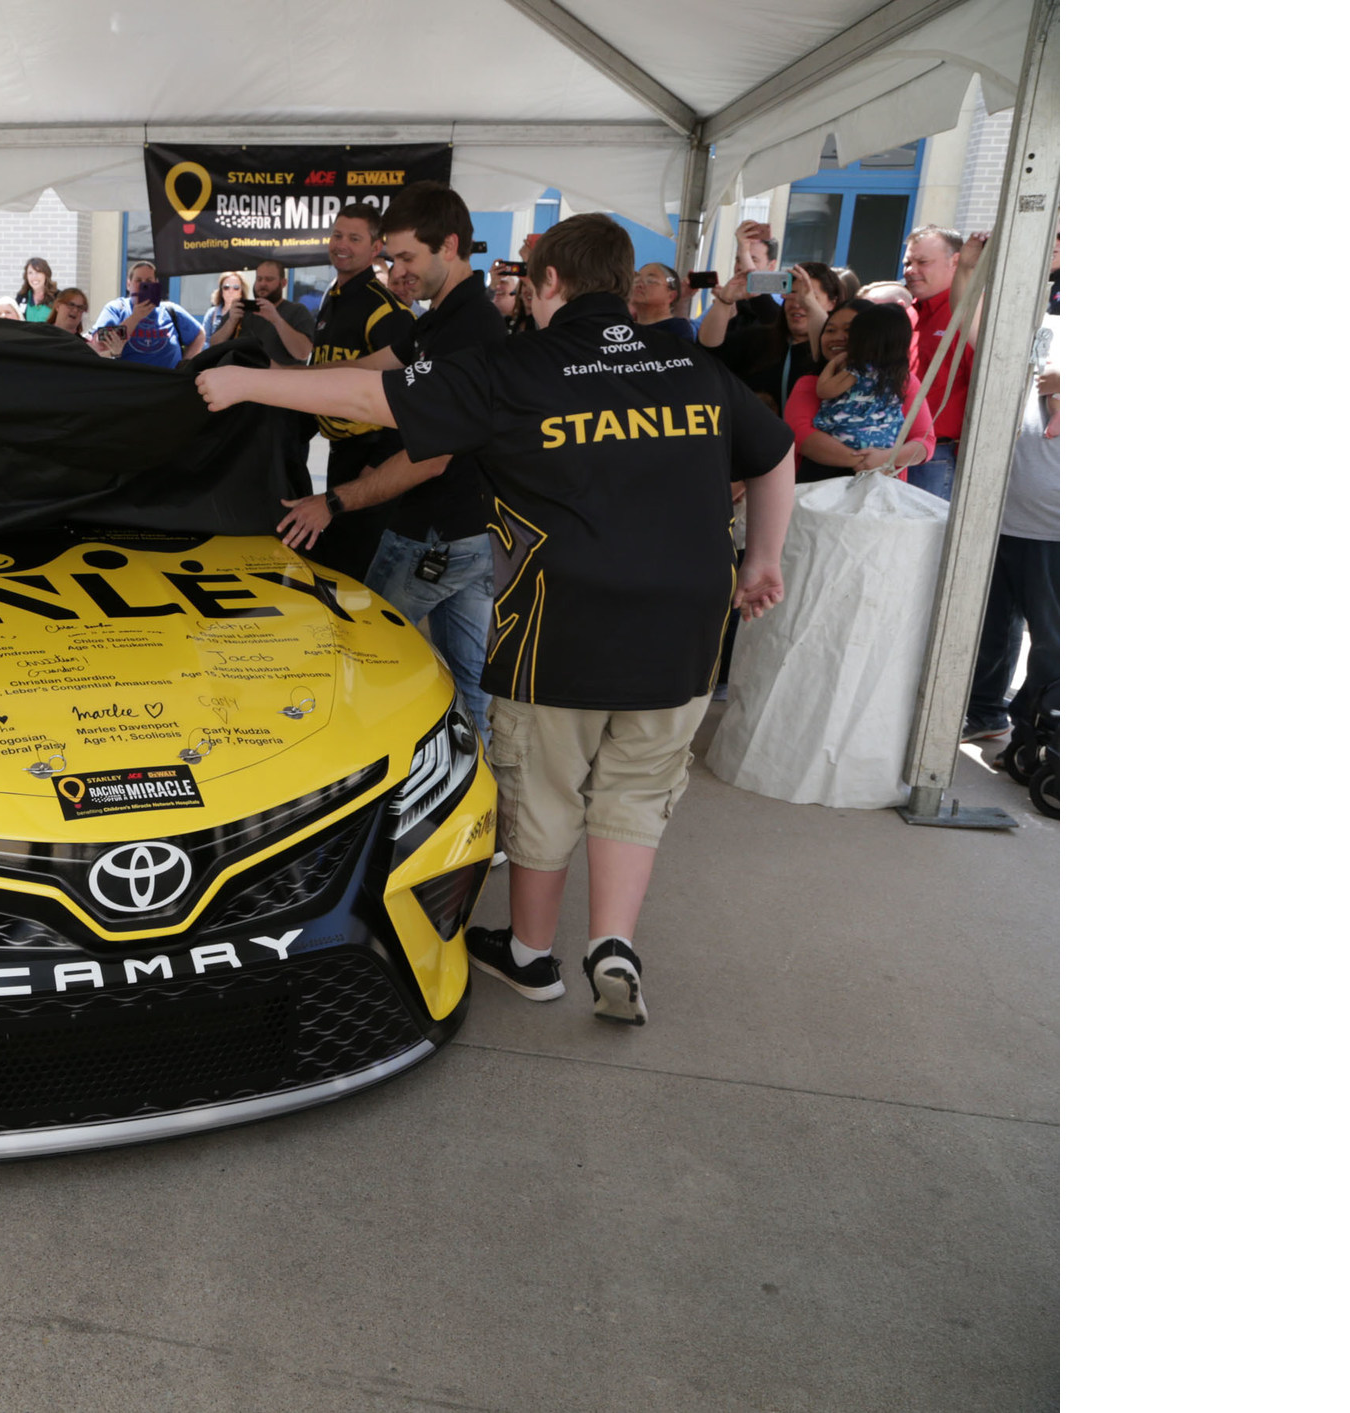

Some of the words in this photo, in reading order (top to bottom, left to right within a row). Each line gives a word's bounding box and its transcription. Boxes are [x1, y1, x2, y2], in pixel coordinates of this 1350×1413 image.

[228, 172, 294, 184] STANLEY
[304, 170, 337, 184] ACE
[217, 194, 282, 216] RACING
[251, 216, 272, 229] FOR
[273, 216, 281, 229] A
[184, 239, 229, 250] benefiting
[231, 237, 280, 248] Children's
[282, 238, 320, 246] Miracle
[600, 341, 646, 354] TOYOTA
[405, 365, 416, 386] OTA
[540, 404, 721, 449] STANLEY
[10, 678, 62, 687] Christian
[64, 674, 116, 683] Guardino
[181, 672, 202, 680] Age
[222, 672, 274, 681] Hodgkin's
[274, 672, 331, 680] Lymphoma
[5, 686, 48, 696] Leber's
[114, 680, 173, 688] Amaurosis
[76, 726, 116, 735] Marlee
[118, 721, 180, 732] Davenport
[202, 727, 232, 735] Carly
[234, 727, 271, 735] Kudzia
[84, 737, 106, 745] Age
[130, 731, 182, 740] Scoliosis
[236, 737, 284, 746] Progeria
[34, 742, 66, 752] Palsy
[86, 774, 122, 784] STANLEY
[88, 784, 126, 798] RACING
[125, 780, 196, 800] MIRACLE
